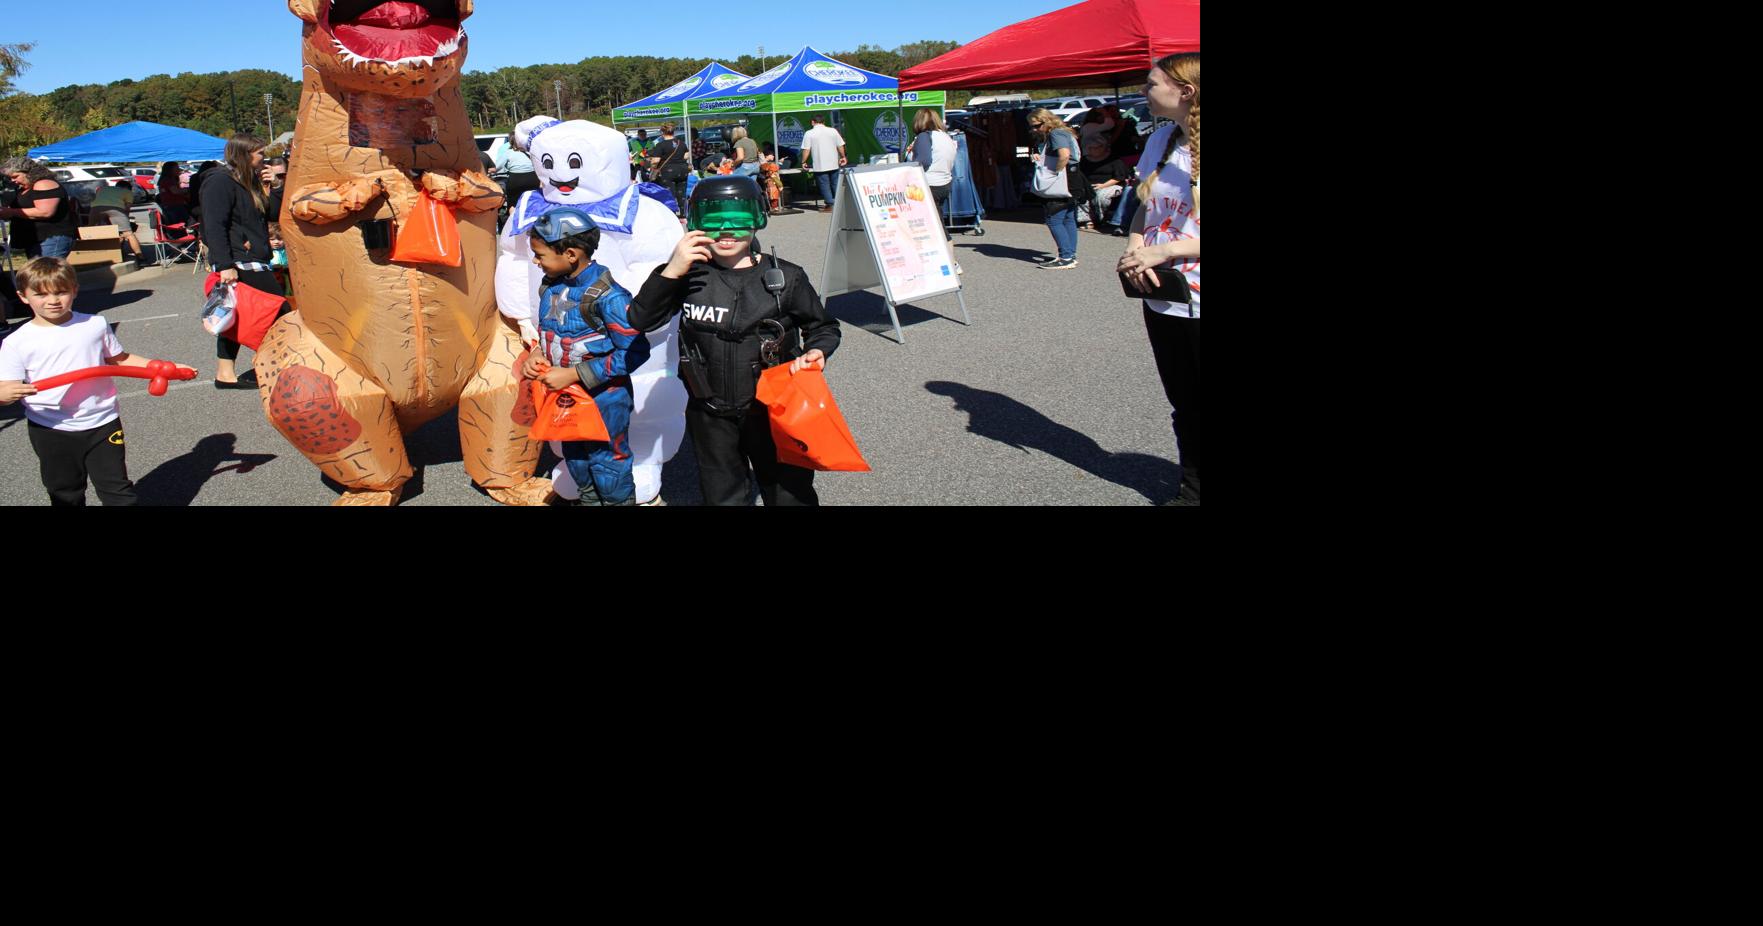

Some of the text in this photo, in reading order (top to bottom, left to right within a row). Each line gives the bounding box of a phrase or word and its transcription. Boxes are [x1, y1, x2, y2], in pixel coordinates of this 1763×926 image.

[805, 91, 918, 105] playcherokee.org
[875, 127, 906, 138] CHEROKE
[869, 192, 906, 208] PUMPKIN
[683, 302, 729, 323] SWAT
